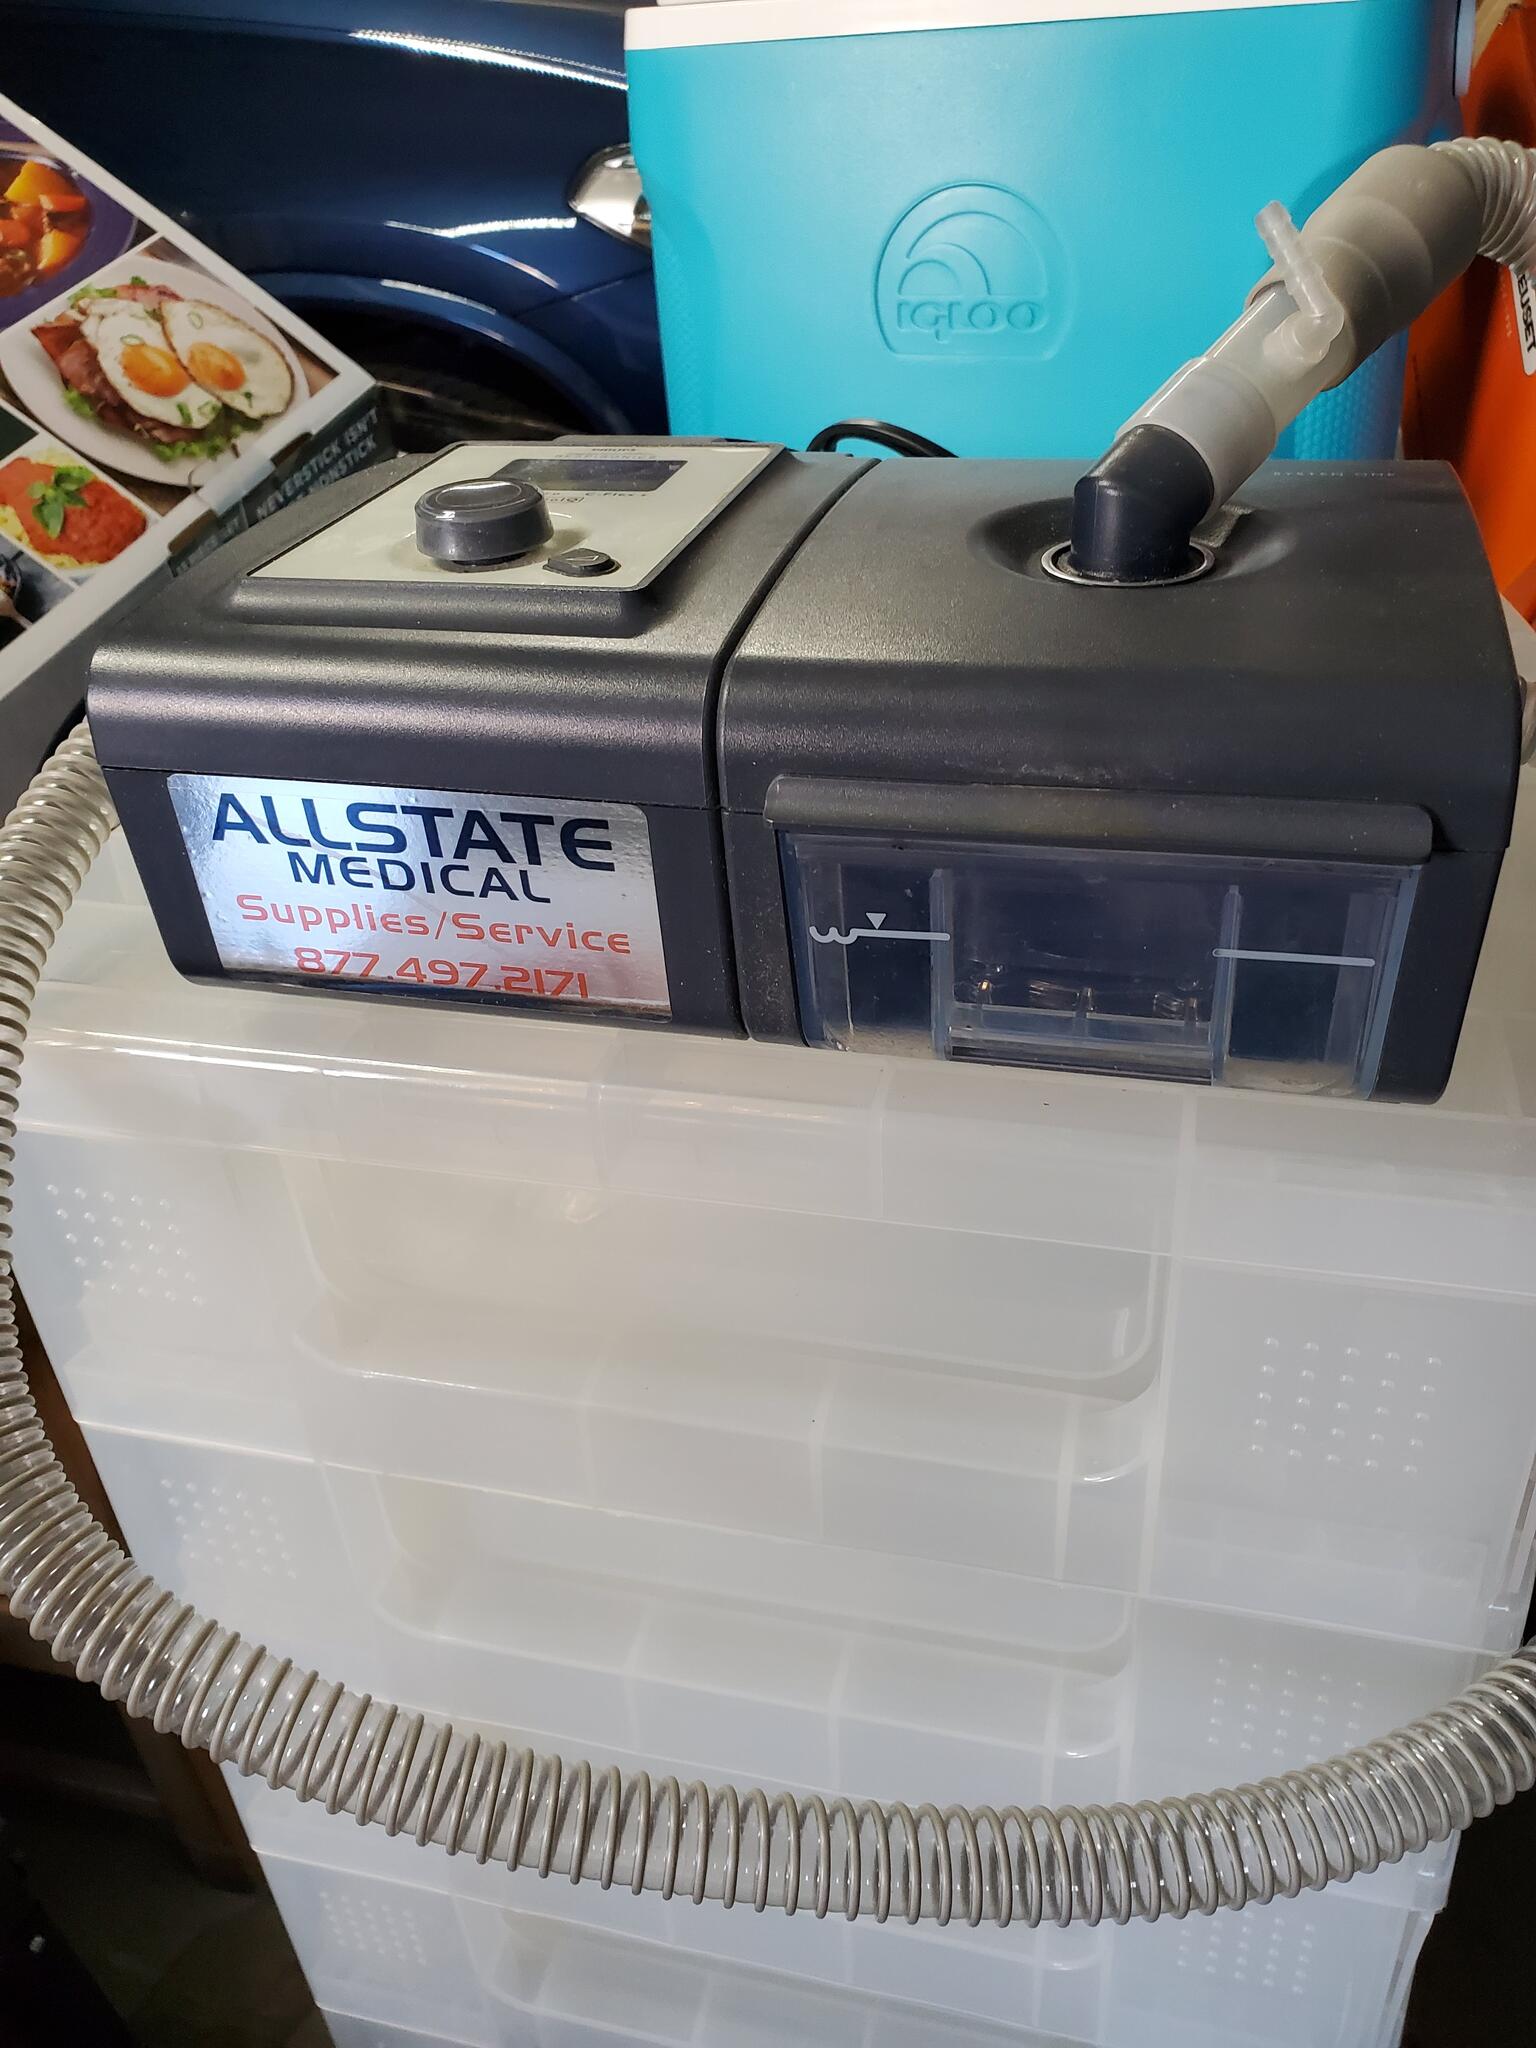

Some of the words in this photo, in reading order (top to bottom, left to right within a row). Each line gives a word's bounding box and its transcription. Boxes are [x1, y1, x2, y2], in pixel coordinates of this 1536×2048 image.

[897, 301, 1044, 344] IGLOO
[1517, 273, 1536, 352] EUSET
[212, 792, 615, 873] ALLSTATE
[288, 851, 552, 904] MEDICAL
[236, 894, 631, 955] Supplies/Service
[293, 946, 590, 999] 877.497.2171
